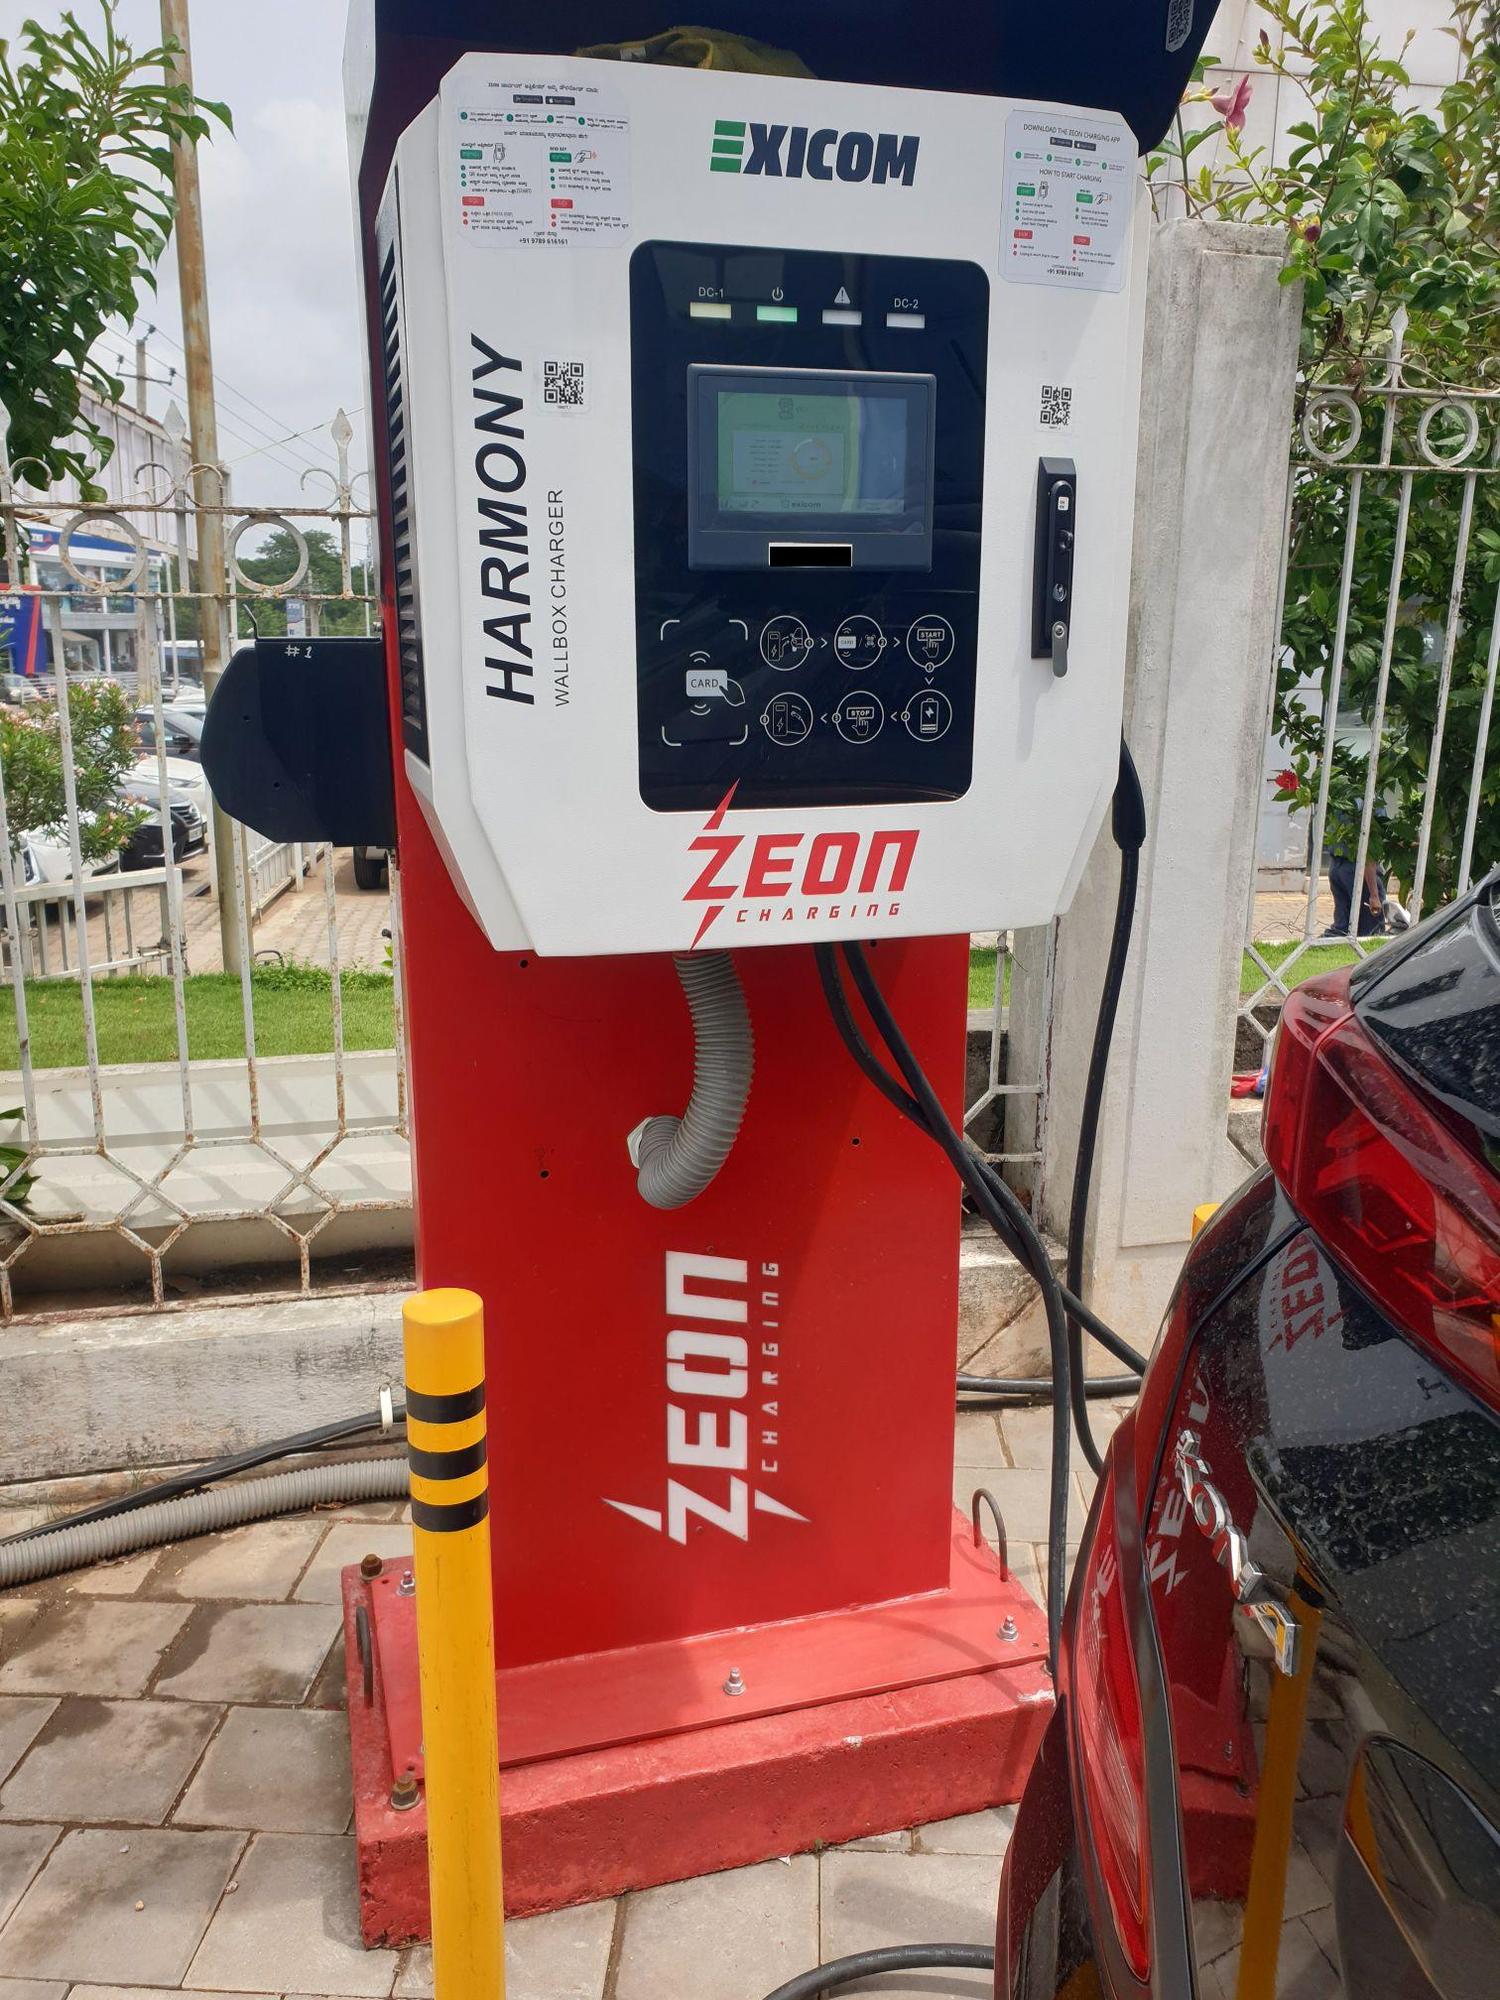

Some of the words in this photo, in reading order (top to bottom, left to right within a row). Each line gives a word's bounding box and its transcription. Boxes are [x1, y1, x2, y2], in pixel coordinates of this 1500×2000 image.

[1023, 124, 1057, 133] DOWNLOAD
[710, 119, 920, 187] EXICOM
[1061, 171, 1075, 179] START
[698, 286, 724, 299] DC-1
[894, 297, 919, 309] DC-2
[471, 332, 535, 705] HARMONY
[548, 488, 567, 599] CHARGER
[551, 604, 569, 707] WALLBOX
[920, 631, 942, 639] START
[690, 678, 719, 689] CARD
[682, 829, 920, 901] ZEON
[736, 903, 900, 923] CHARGING
[762, 1262, 779, 1473] CHARGING
[665, 1250, 748, 1546] ZEON
